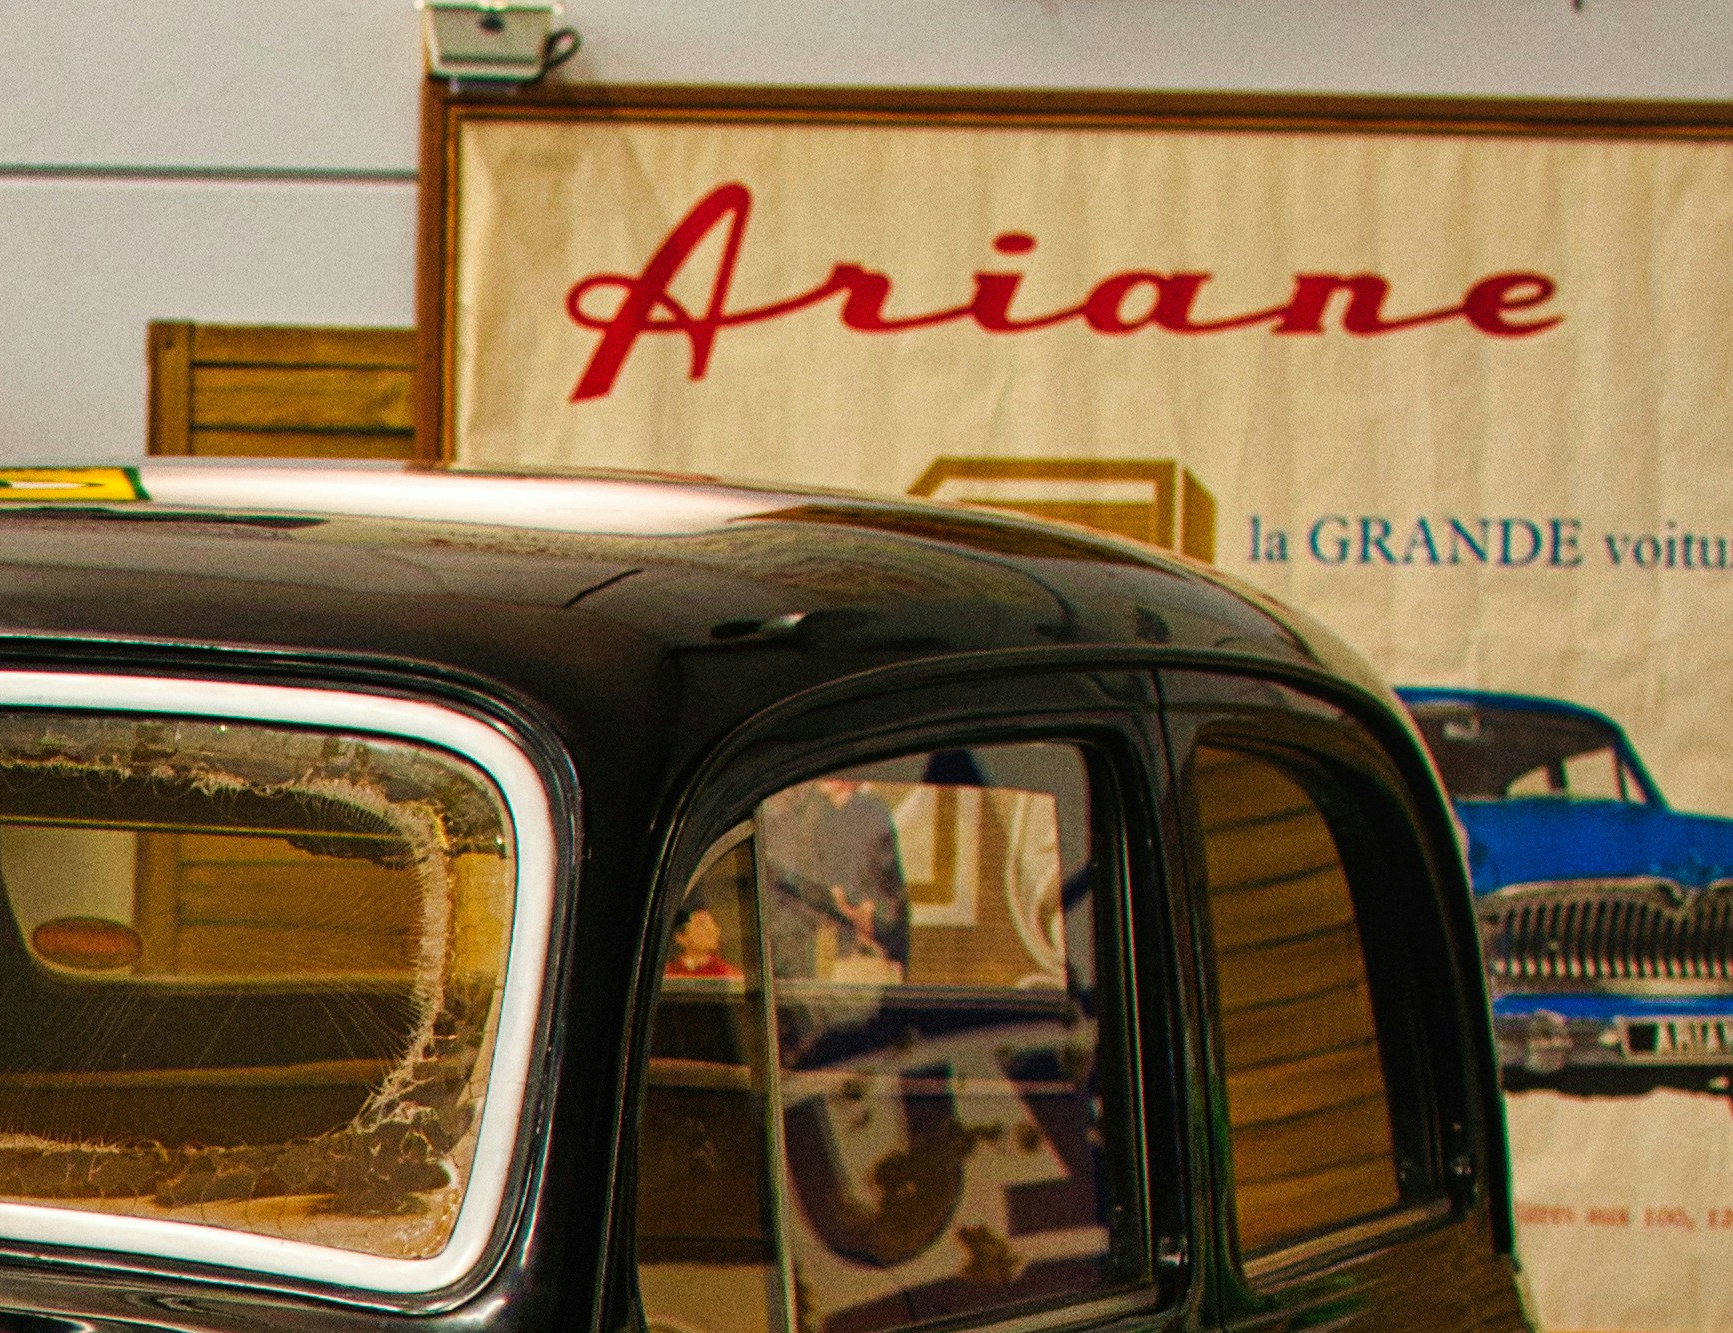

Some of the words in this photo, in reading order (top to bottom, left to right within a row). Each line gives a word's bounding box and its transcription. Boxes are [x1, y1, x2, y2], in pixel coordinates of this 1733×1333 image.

[564, 181, 1564, 403] Ariane
[1247, 515, 1289, 563] la
[1307, 515, 1583, 567] GRANDE
[1603, 520, 1733, 568] voitu
